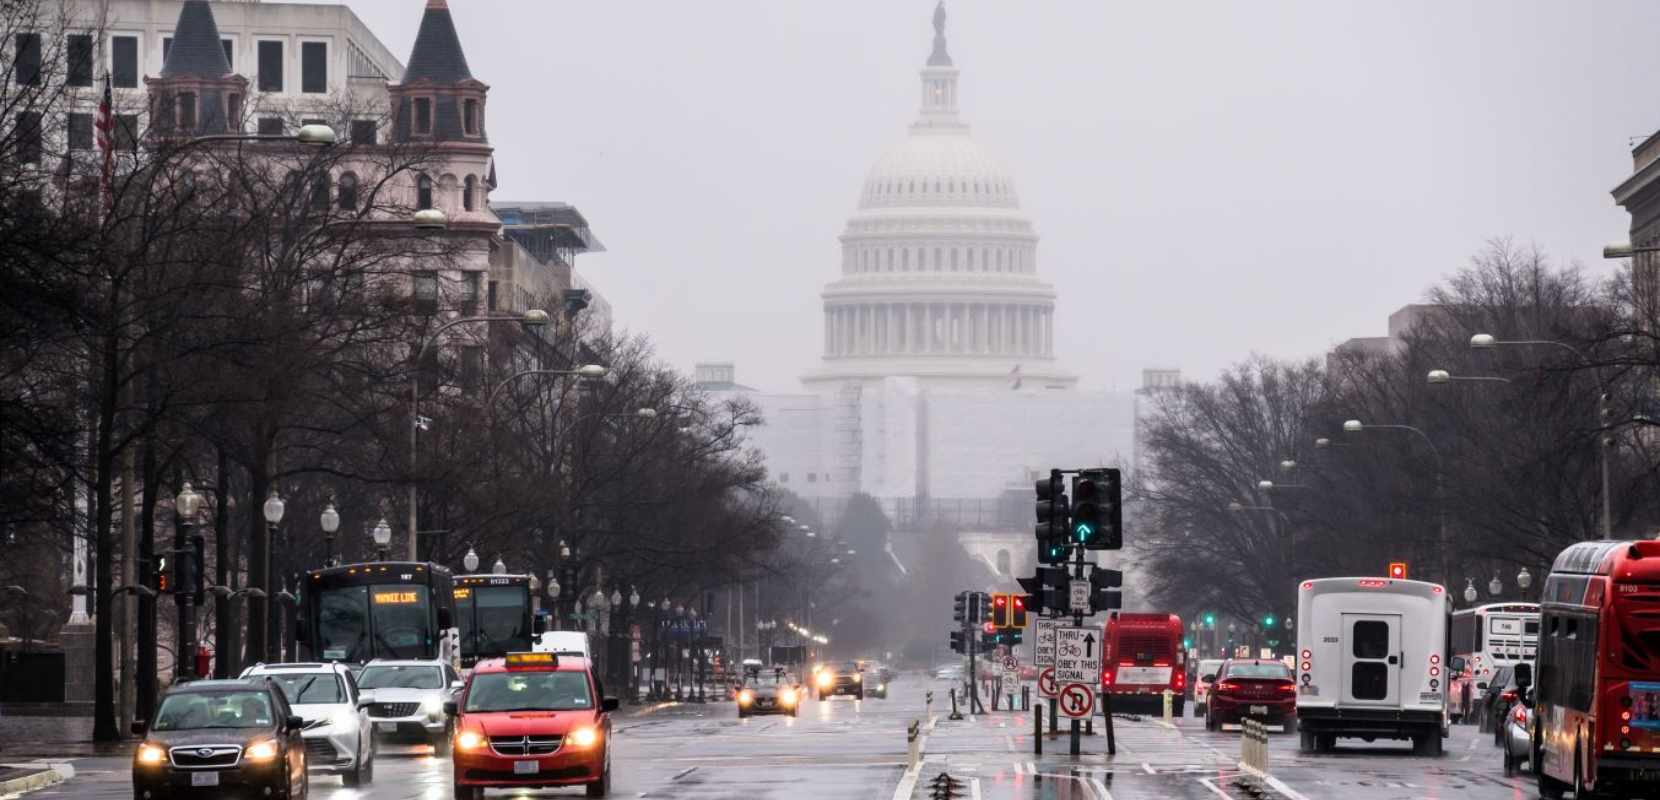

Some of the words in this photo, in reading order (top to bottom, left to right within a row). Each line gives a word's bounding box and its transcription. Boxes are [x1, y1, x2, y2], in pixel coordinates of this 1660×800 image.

[374, 593, 398, 603] YANKEE
[400, 593, 417, 602] LINE
[1058, 631, 1080, 640] THRU
[1037, 646, 1055, 654] OBEY
[1057, 660, 1078, 669] OBEY
[1081, 661, 1098, 670] THIS
[1057, 670, 1085, 680] SIGNAL
